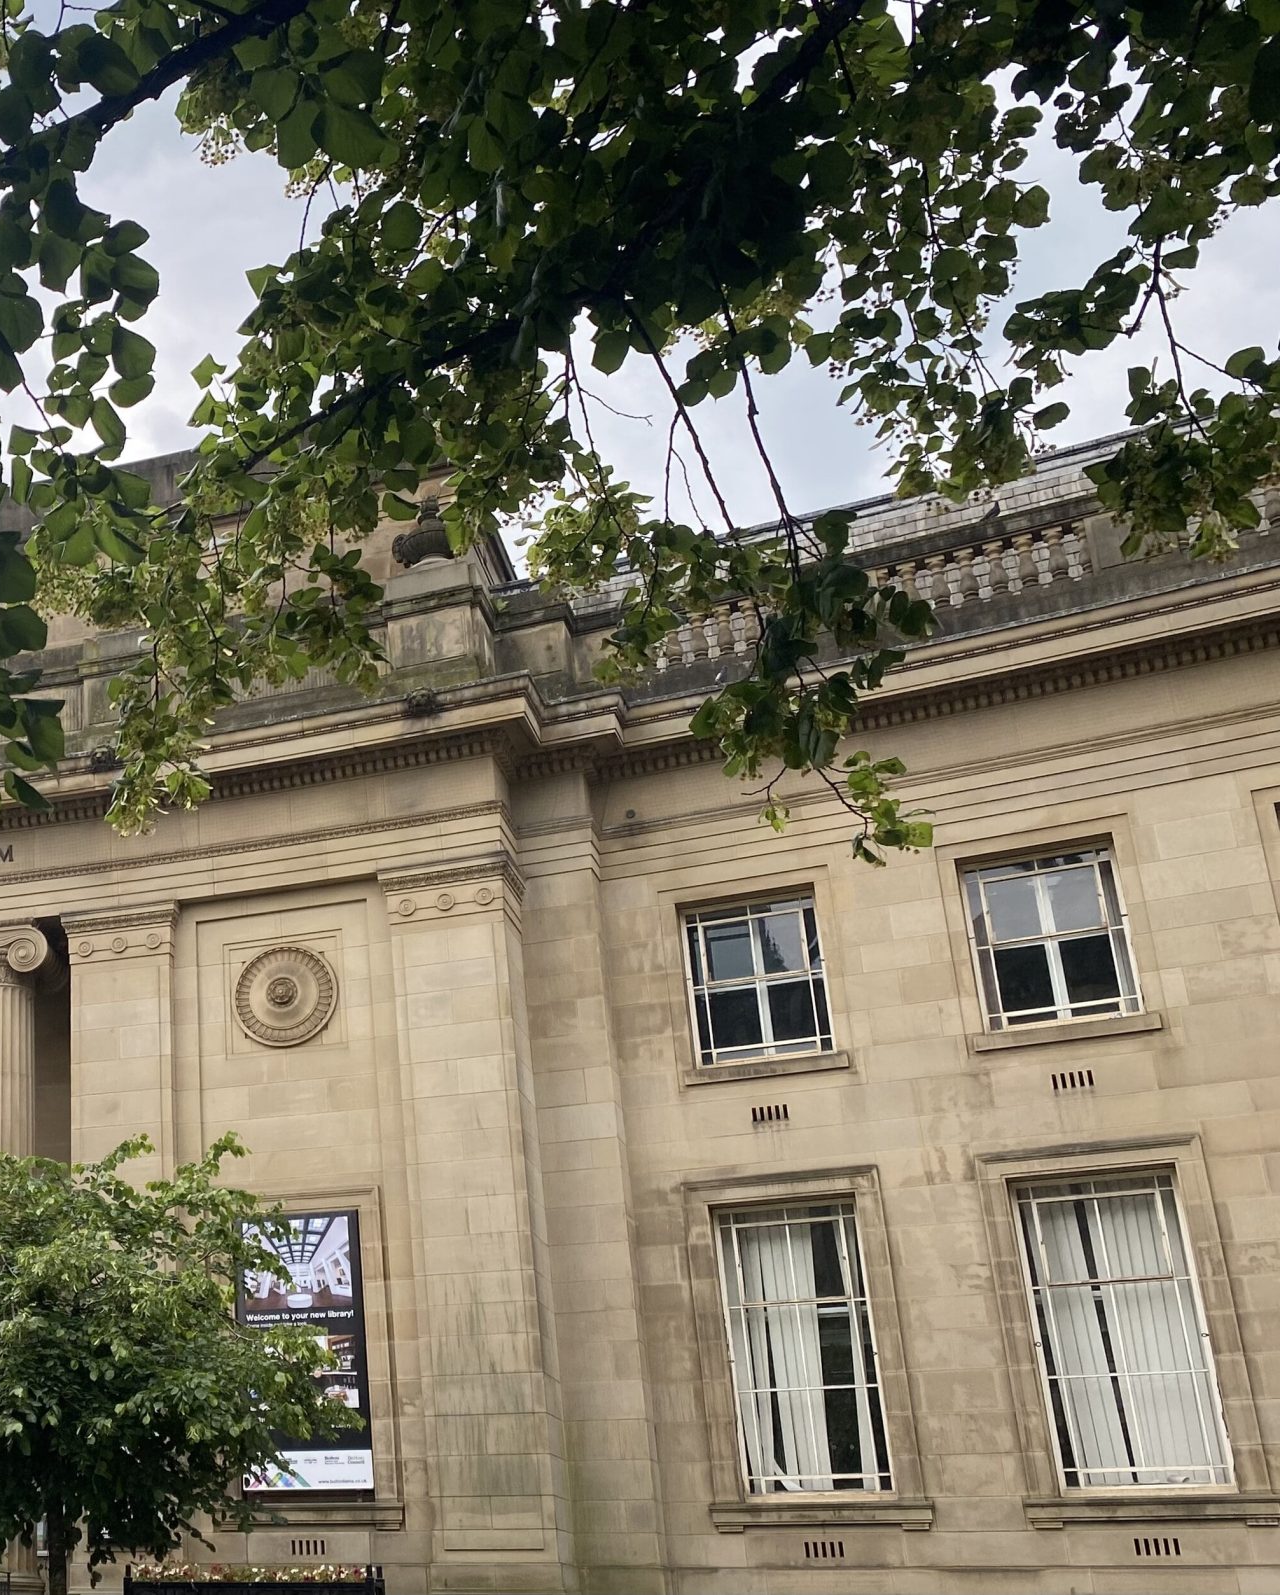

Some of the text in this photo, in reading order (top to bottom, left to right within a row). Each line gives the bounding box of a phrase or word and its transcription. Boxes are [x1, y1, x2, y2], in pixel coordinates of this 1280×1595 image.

[246, 1309, 354, 1321] Welcome to your new library!
